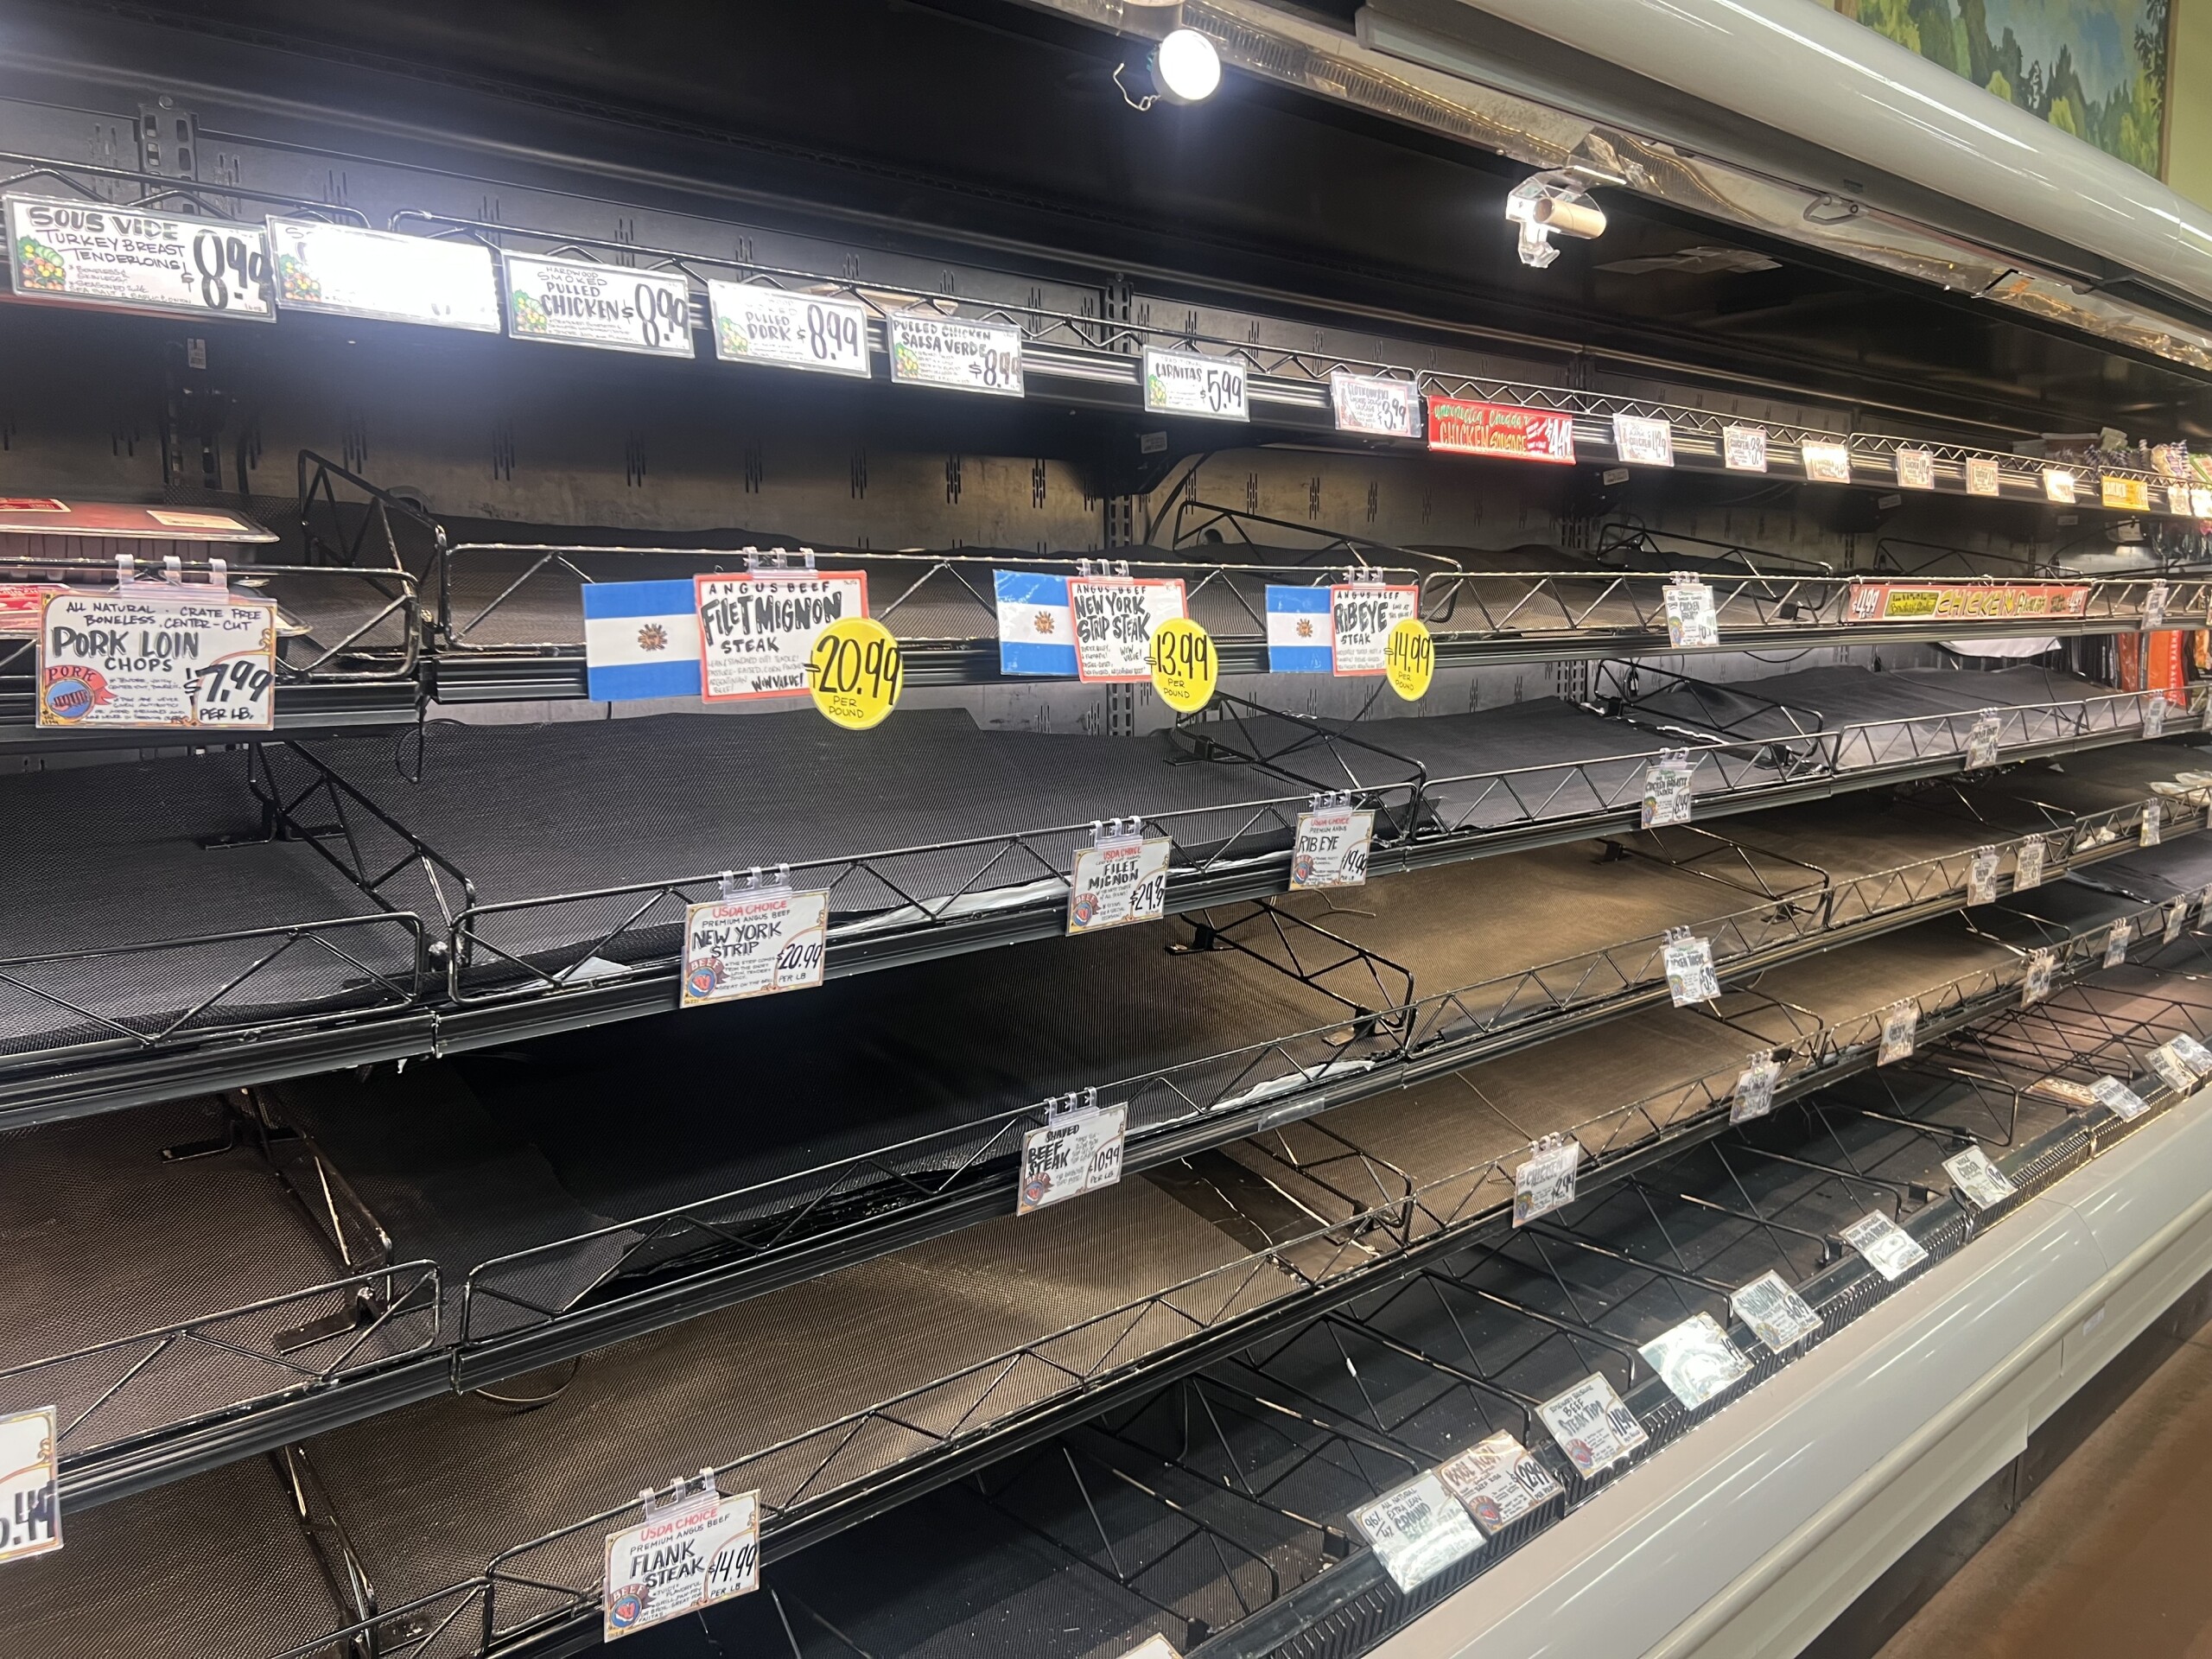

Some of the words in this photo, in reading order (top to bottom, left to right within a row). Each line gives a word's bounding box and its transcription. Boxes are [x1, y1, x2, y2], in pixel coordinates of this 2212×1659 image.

[27, 207, 105, 232] SOUS
[111, 216, 179, 240] VIDE
[35, 229, 118, 250] TURKEY
[123, 241, 185, 257] BREAST
[58, 246, 180, 270] TENDERLOINS
[537, 271, 607, 286] SMOKED
[546, 267, 599, 278] HARDWOOD
[547, 282, 601, 297] PULLED
[541, 295, 619, 321] CHICKEN
[745, 311, 790, 326] PULLED
[747, 323, 791, 341] PORK
[797, 304, 859, 359] $8.99
[893, 320, 938, 334] PULLED
[942, 325, 990, 340] CHICKEN
[902, 332, 942, 353] SALSA
[944, 340, 987, 358] VERDE
[1155, 363, 1203, 382] CARNITAS
[1200, 370, 1242, 412] $5.99
[1440, 422, 1489, 448] CHICKEN
[1490, 431, 1527, 455] SAUSAGE
[709, 582, 779, 595] ANGUS
[787, 581, 830, 594] BEEF
[1077, 585, 1109, 594] ANGUS
[1119, 586, 1147, 594] BEEF
[67, 601, 86, 613] ALL
[93, 602, 156, 613] NATURAL
[180, 607, 223, 618] CRATE
[232, 608, 261, 620] FREE
[1074, 594, 1104, 620] NEW
[1105, 592, 1146, 616] YORK
[1937, 588, 2015, 617] CHICKEN
[84, 614, 156, 626] BONELESS
[701, 594, 753, 647] FILET
[755, 591, 842, 635] MIGNON
[1334, 601, 1388, 634] RIBEYE
[1077, 616, 1109, 644] STRIP
[1112, 612, 1151, 644] STEAK
[51, 626, 129, 658] PORK
[139, 630, 199, 659] LOIN
[721, 637, 779, 654] STEAK
[1341, 633, 1370, 645] STEAK
[1143, 631, 1208, 681] $13.99
[1383, 632, 1431, 676] $14.99
[105, 658, 173, 672] CHOPS
[47, 668, 96, 683] PORK
[183, 660, 273, 705] $7.99
[1167, 679, 1185, 688] PER
[1395, 680, 1414, 690] POUND
[1398, 671, 1411, 682] PER
[833, 696, 856, 707] PER
[1163, 688, 1190, 699] POUND
[200, 709, 227, 721] PER
[830, 707, 864, 719] POUND
[1103, 850, 1121, 861] USDA
[1122, 847, 1141, 857] CHOICE
[1299, 836, 1318, 853] RIB
[1319, 836, 1339, 852] EYE
[1104, 860, 1138, 876] FILET
[1088, 869, 1139, 891] MIGNON
[702, 918, 741, 928] PREMIUM
[743, 913, 768, 922] ANGUS
[772, 909, 791, 918] BEEF
[712, 906, 744, 919] USDA
[746, 900, 787, 916] CHOICE
[691, 926, 730, 951] NEW
[737, 921, 783, 943] YORK
[711, 941, 760, 959] STRIP
[776, 942, 823, 970] $20.99
[691, 959, 721, 969] BEEF
[779, 974, 792, 982] PER
[1046, 1124, 1079, 1141] SHAVED
[1028, 1140, 1063, 1164] BEEF
[1029, 1148, 1071, 1176] STEAK
[1090, 1175, 1103, 1184] PER
[1562, 1398, 1585, 1417] BEEF
[1558, 1408, 1590, 1437] STEAK
[1583, 1400, 1605, 1421] TIPS
[1444, 1463, 1477, 1487] BOOL
[1381, 1499, 1393, 1511] ALL
[1391, 1487, 1417, 1506] NATURAL
[1535, 1491, 1544, 1499] PER
[1387, 1505, 1408, 1520] EXTRA
[1406, 1495, 1422, 1510] LEAN
[1395, 1502, 1432, 1530] GROUND
[641, 1524, 673, 1541] USDA
[676, 1508, 717, 1529] CHOICE
[1364, 1511, 1383, 1529] 96%
[630, 1535, 673, 1555] PREMIUM
[677, 1525, 703, 1539] ANGUS
[708, 1514, 730, 1528] BEEF
[1380, 1524, 1394, 1539] 4%
[630, 1539, 695, 1580] FLANK
[708, 1543, 757, 1583] $14.99
[643, 1556, 705, 1588] STEAK
[613, 1586, 644, 1601] BEEF
[710, 1588, 726, 1598] PER
[731, 1582, 741, 1592] LB
